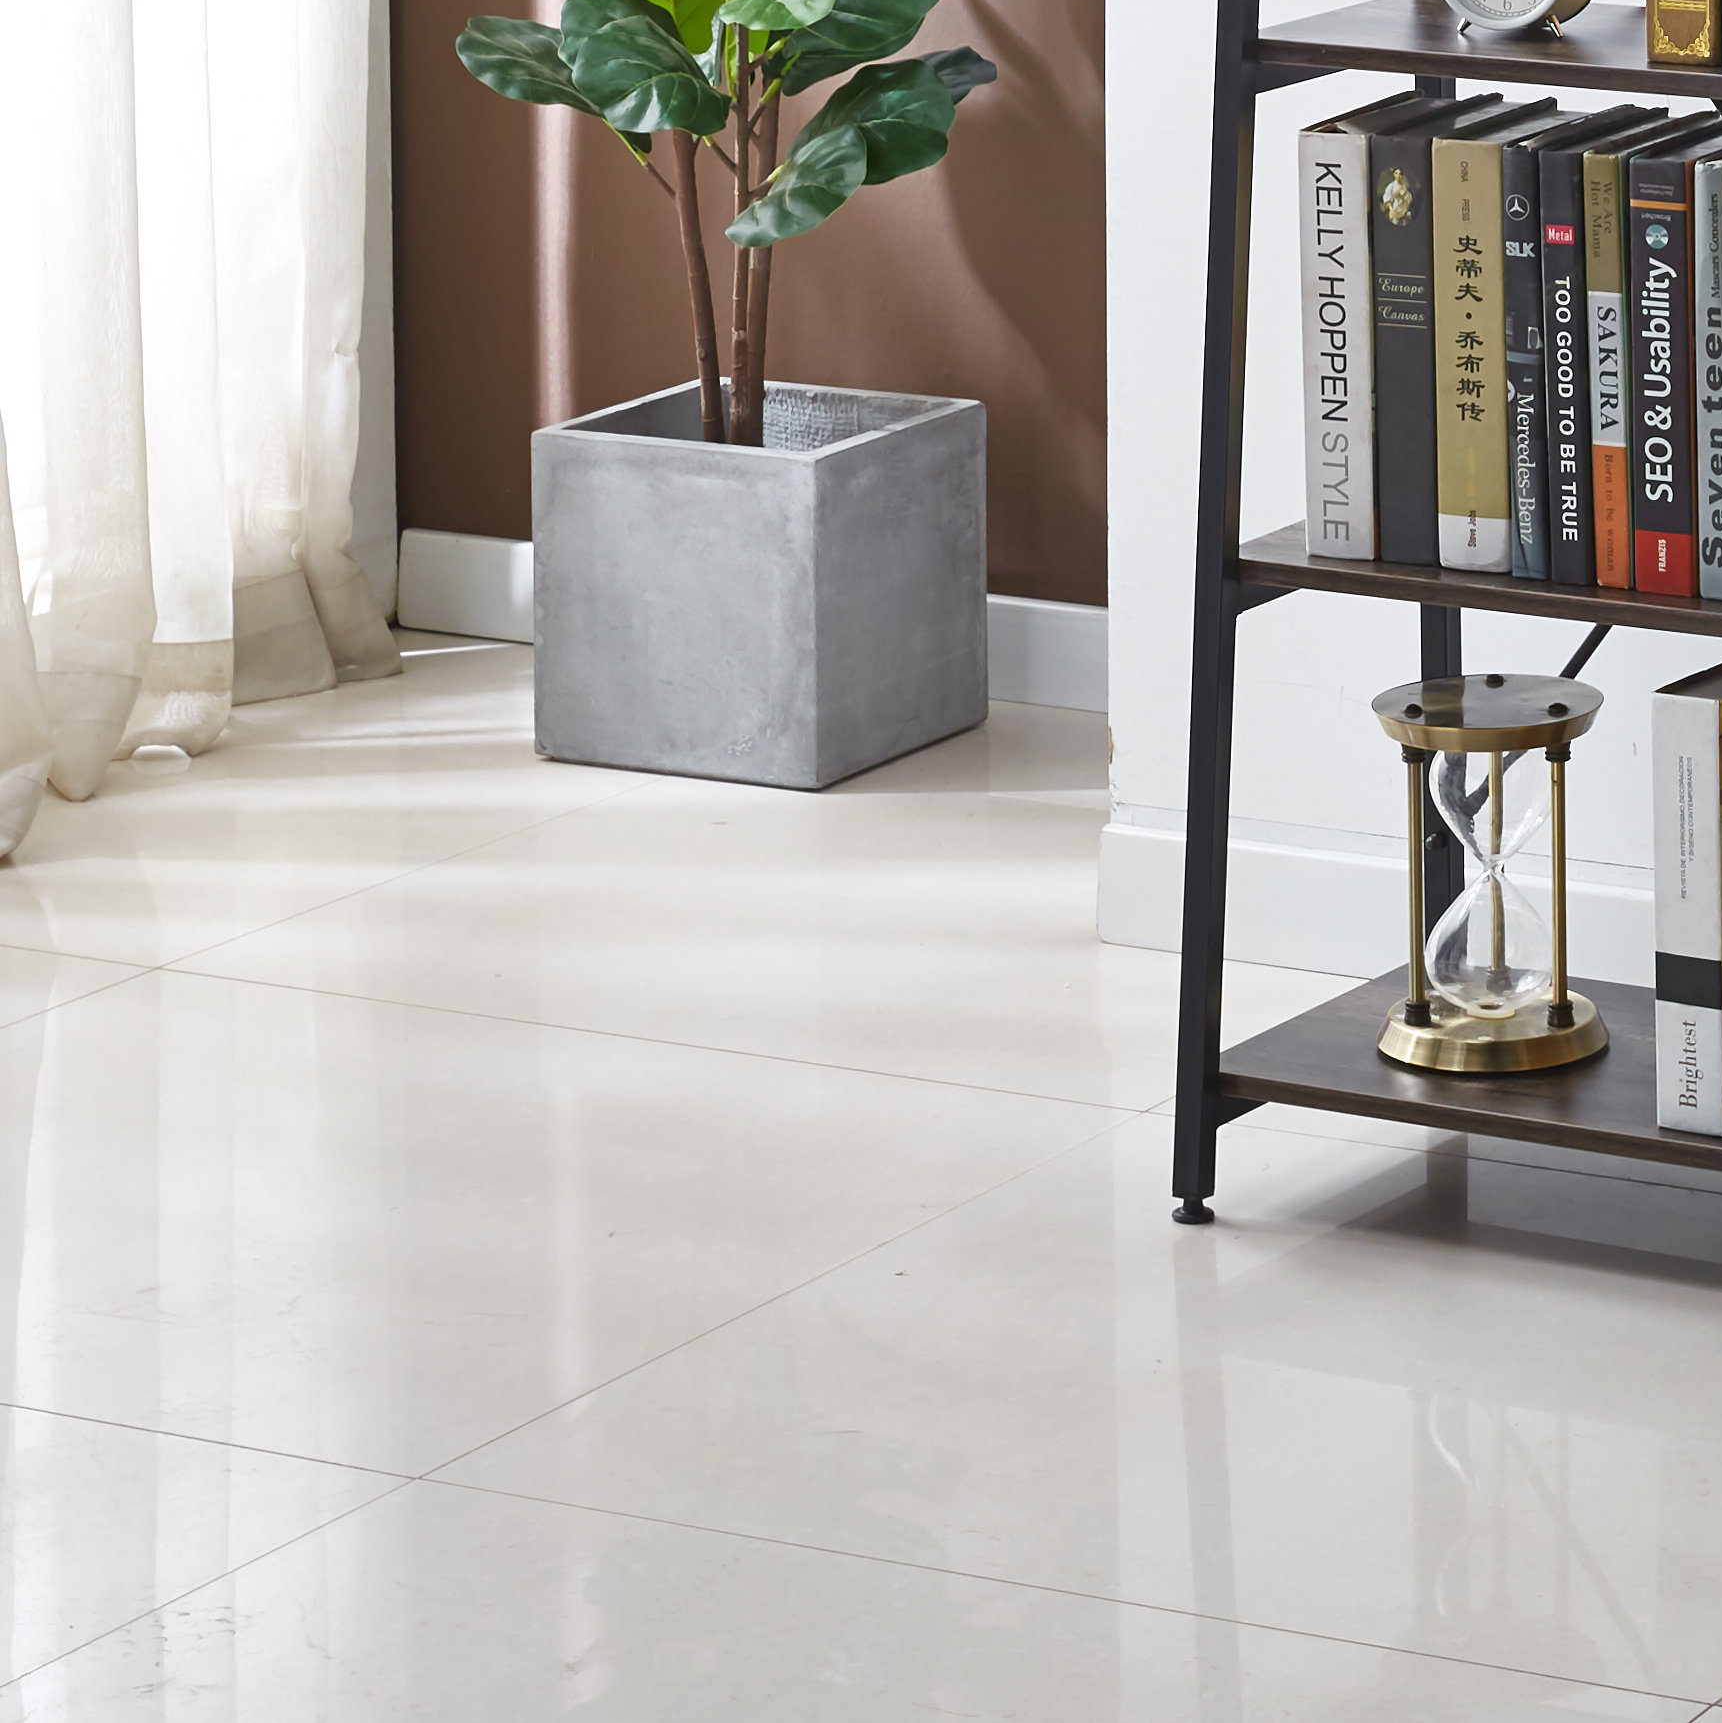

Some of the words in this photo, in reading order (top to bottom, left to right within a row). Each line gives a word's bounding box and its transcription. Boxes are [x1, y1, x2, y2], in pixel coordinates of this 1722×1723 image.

[1315, 162, 1345, 269] KELLY
[1548, 227, 1573, 242] Metal
[1505, 241, 1536, 258] SLK
[1378, 278, 1424, 297] Europe
[1378, 305, 1425, 321] Canvas
[1555, 276, 1572, 323] TOO
[1318, 276, 1348, 422] HOPPEN
[1641, 257, 1677, 398] Usability
[1556, 331, 1574, 398] GOOD
[1597, 306, 1619, 431] SAKURA
[1702, 307, 1722, 413] teen
[1558, 405, 1575, 436] TO
[1643, 405, 1672, 430] &
[1321, 431, 1350, 542] STYLE
[1516, 392, 1536, 545] Mercedes-Benz
[1559, 444, 1576, 474] BE
[1644, 436, 1674, 503] SEO
[1561, 481, 1578, 542] TRUE
[1658, 539, 1667, 572] FRANZIS
[1678, 1020, 1704, 1110] Brightest
